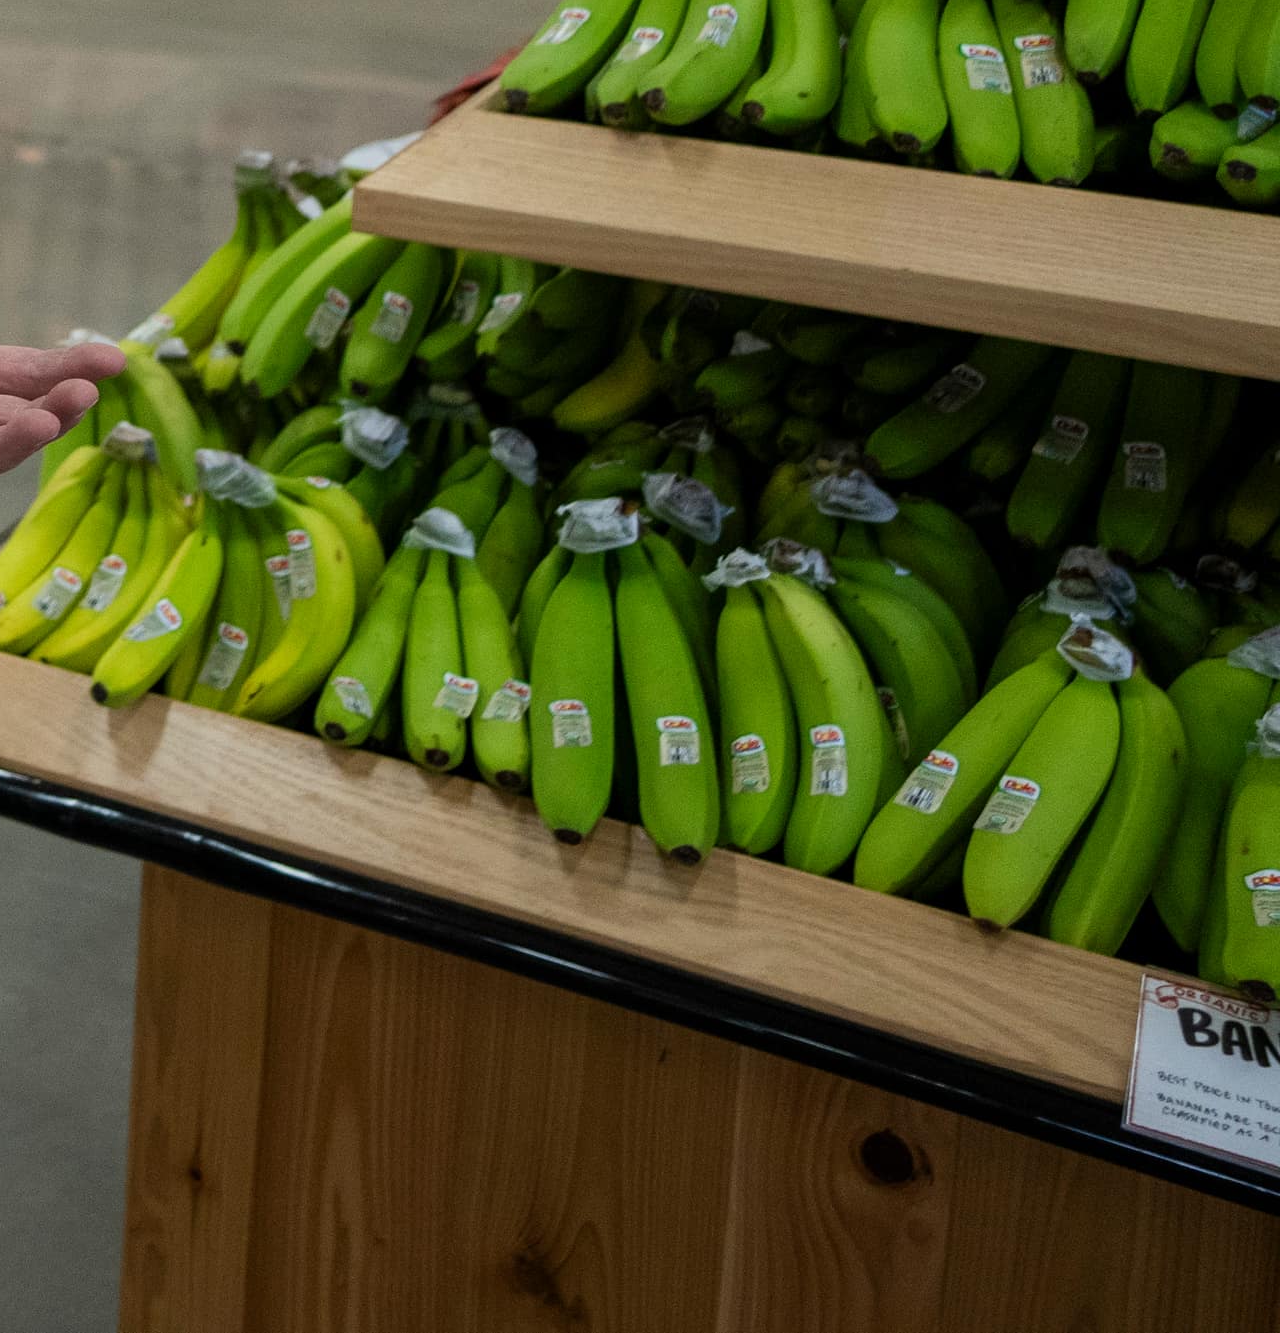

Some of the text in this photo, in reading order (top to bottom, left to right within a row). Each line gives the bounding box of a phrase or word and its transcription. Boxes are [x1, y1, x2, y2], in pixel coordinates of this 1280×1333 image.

[1004, 779, 1036, 794] Dole
[1173, 985, 1261, 1022] ORGANIC
[1157, 1071, 1188, 1086] BEST
[1194, 1081, 1231, 1099] PRICE
[1236, 1094, 1250, 1103] IN
[1156, 1092, 1218, 1117] BANANAS
[1224, 1112, 1250, 1125] ARE
[1162, 1106, 1230, 1131] CLASSIFIED
[1235, 1128, 1253, 1137] AS
